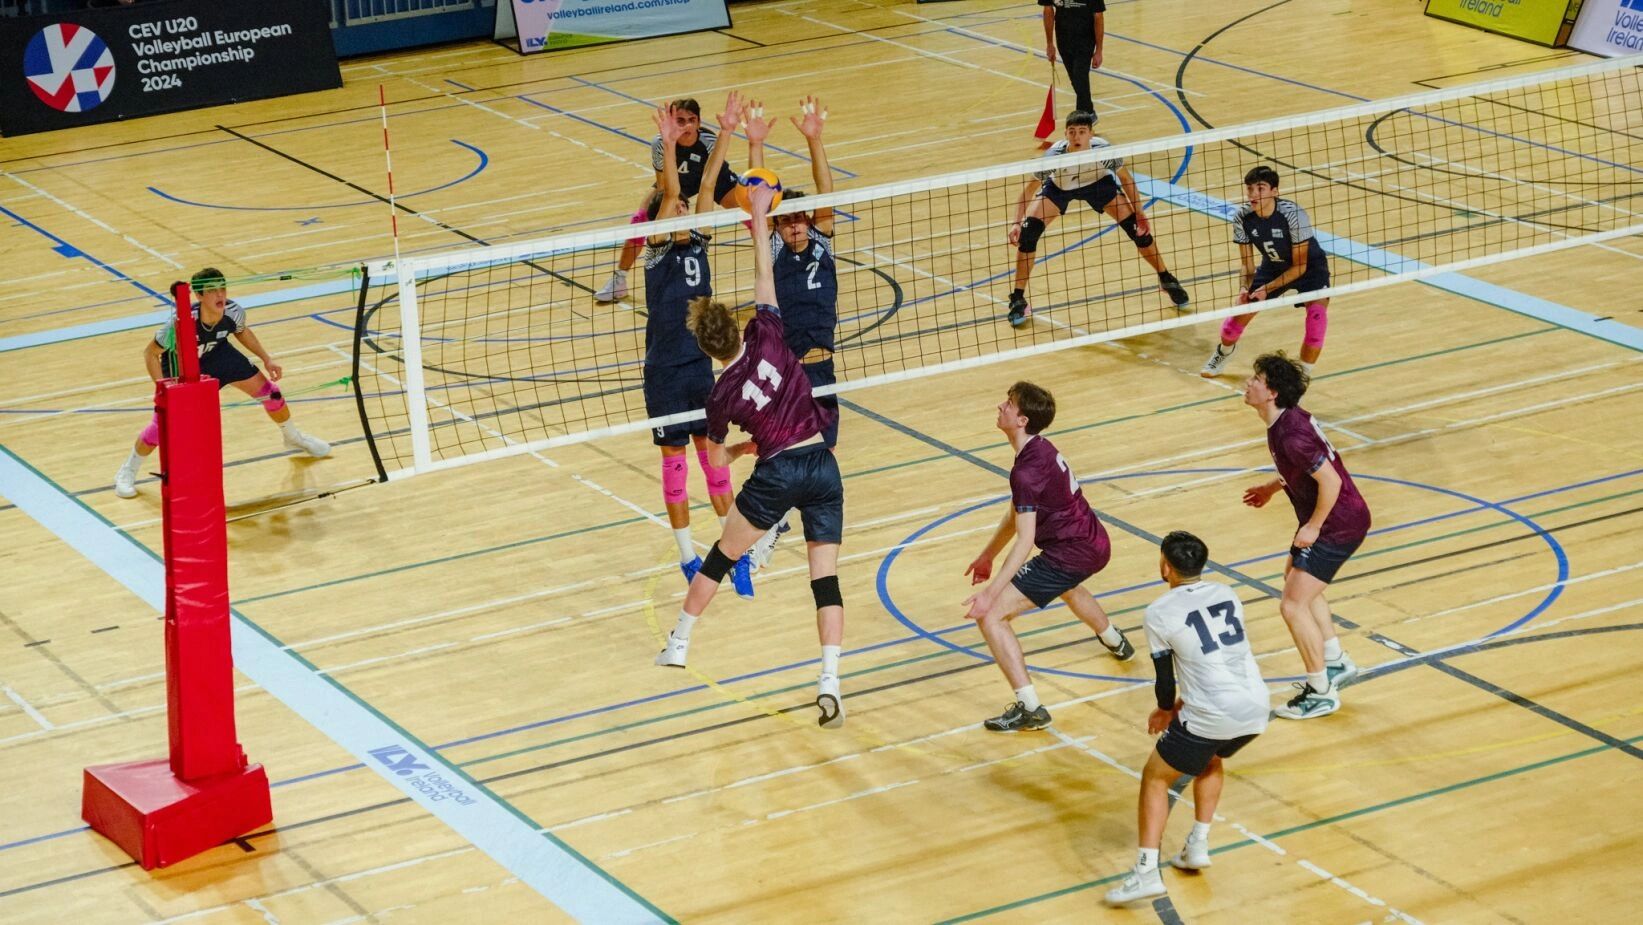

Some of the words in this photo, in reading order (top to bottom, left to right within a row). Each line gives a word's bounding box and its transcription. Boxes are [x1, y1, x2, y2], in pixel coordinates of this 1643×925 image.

[128, 21, 161, 39] CEV
[165, 16, 198, 34] U20
[131, 31, 212, 57] Volleyball
[214, 23, 292, 43] European
[137, 45, 255, 75] Championship
[141, 73, 182, 92] 2024
[1263, 240, 1281, 262] 5
[684, 256, 701, 287] 9
[805, 261, 822, 290] 2
[742, 358, 783, 412] 11
[1184, 600, 1245, 655] 13
[424, 771, 478, 806] Volleyball
